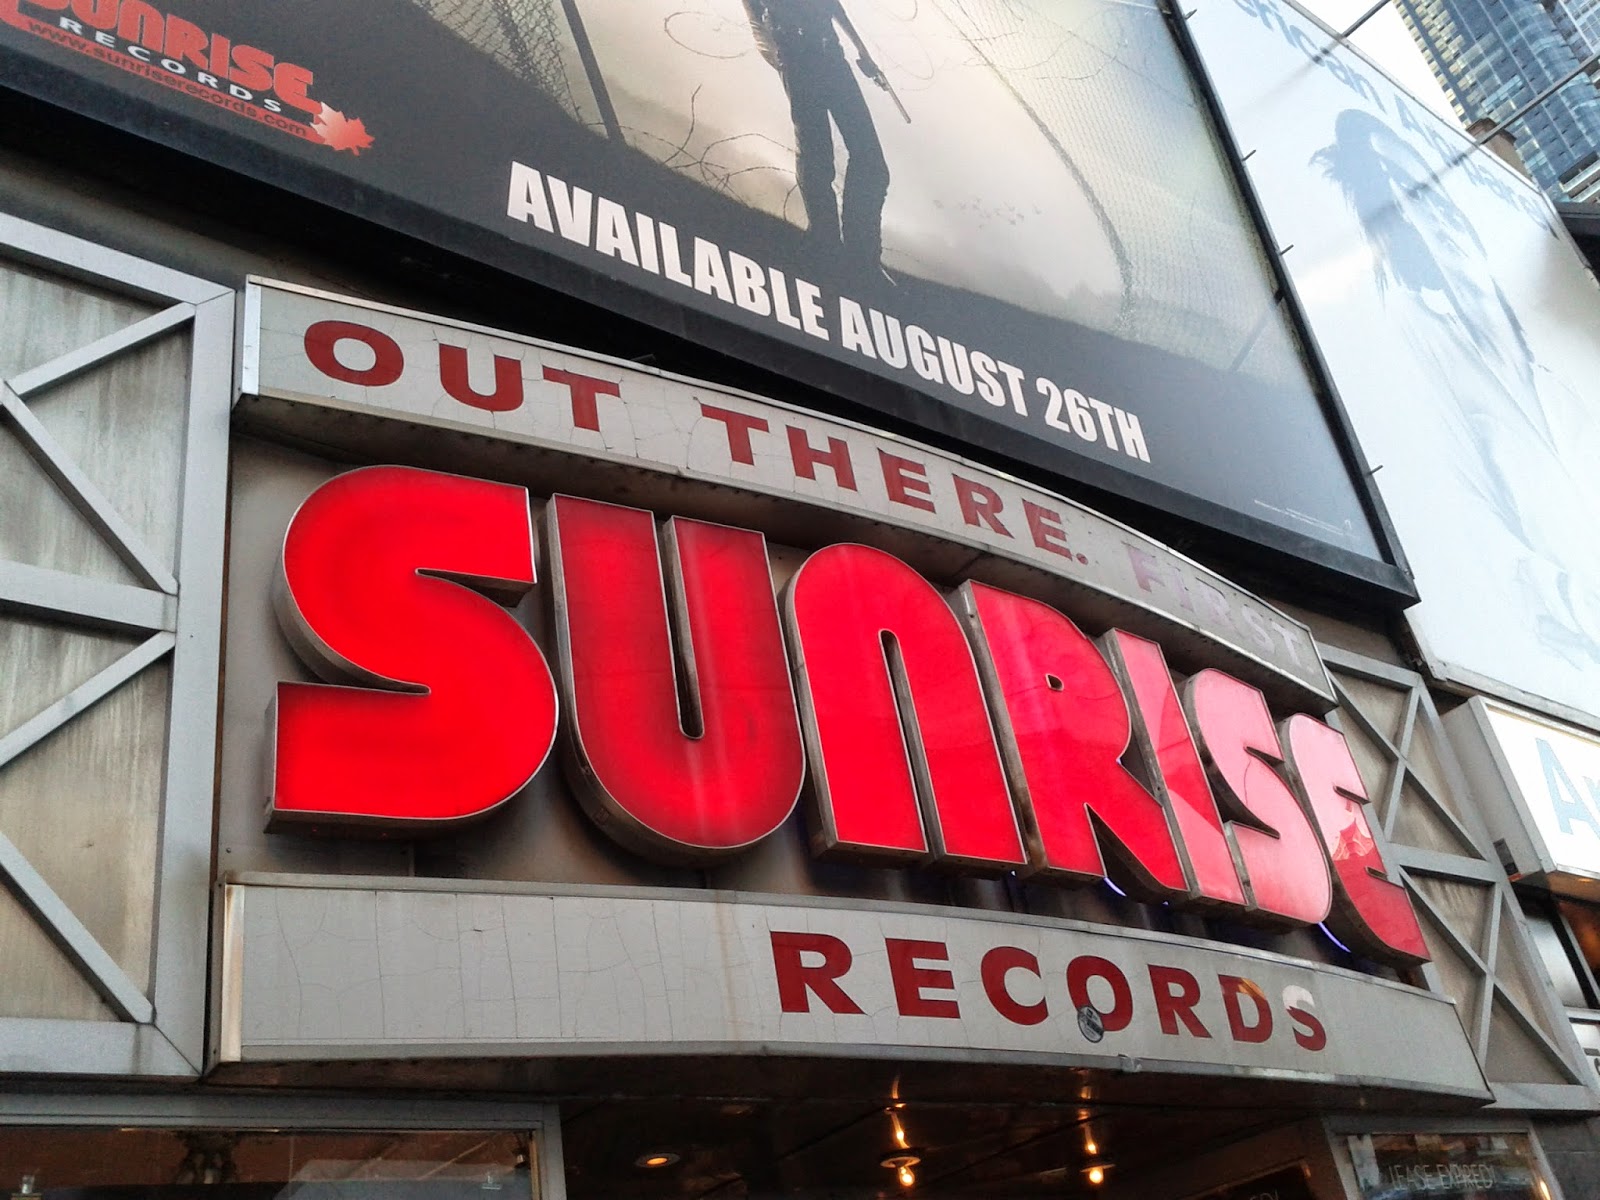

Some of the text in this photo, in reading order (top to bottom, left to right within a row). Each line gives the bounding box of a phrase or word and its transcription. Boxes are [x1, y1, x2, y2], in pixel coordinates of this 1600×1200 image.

[27, 20, 307, 136] www.sunriserecords.com
[59, 16, 282, 113] RECORDS
[1393, 92, 1561, 241] Apparel
[506, 160, 1151, 463] AVAILABLE AUGUST 26TH
[304, 320, 621, 432] OUT
[700, 403, 1090, 565] THERE.
[265, 464, 1429, 963] SUNRISE
[770, 930, 1327, 1051] RECORDS
